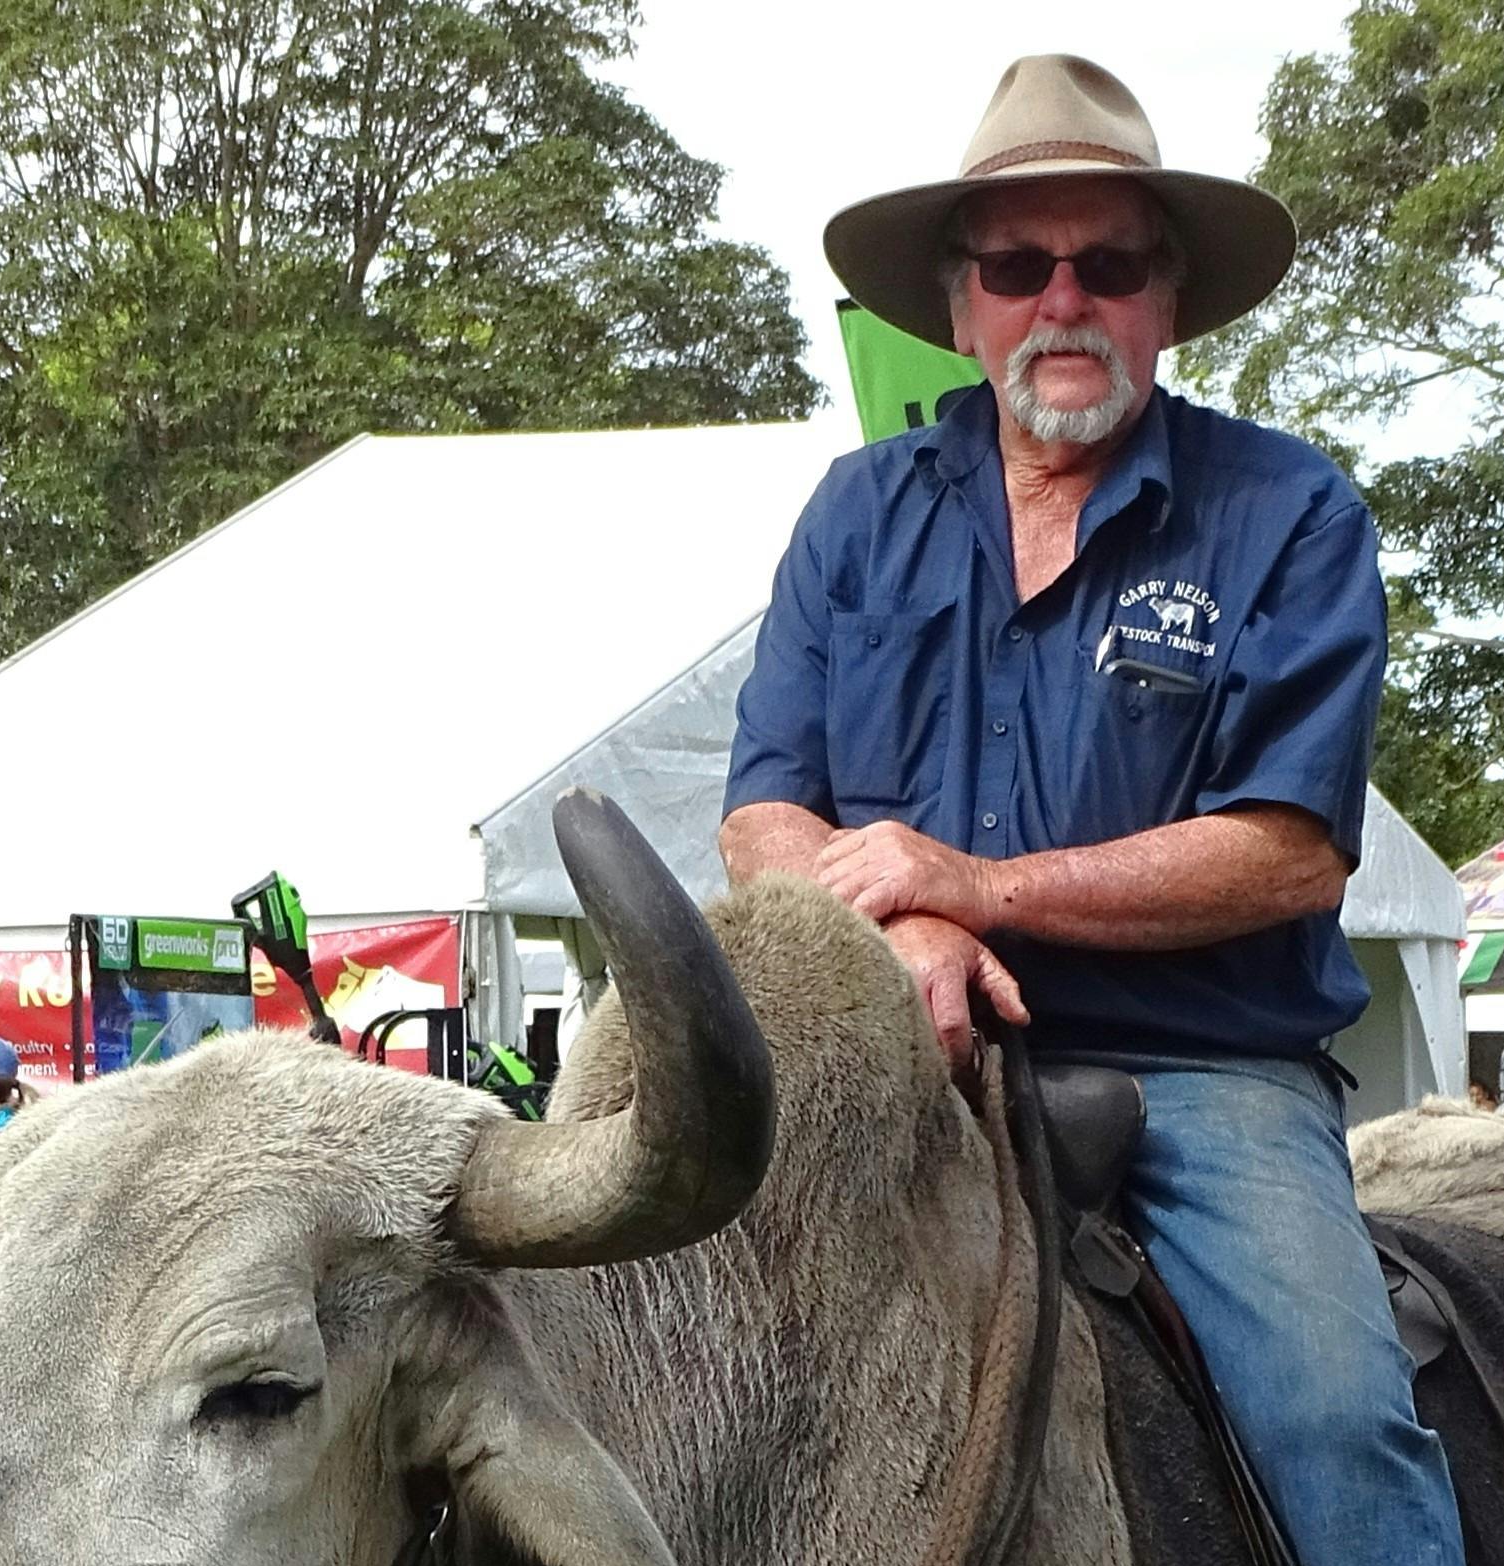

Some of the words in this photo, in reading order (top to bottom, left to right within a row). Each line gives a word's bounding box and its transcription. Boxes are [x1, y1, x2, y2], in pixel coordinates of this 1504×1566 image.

[1118, 579, 1167, 608] GARRY
[1173, 580, 1223, 624] NELSON
[143, 930, 210, 959] greenworks
[215, 939, 240, 963] pro
